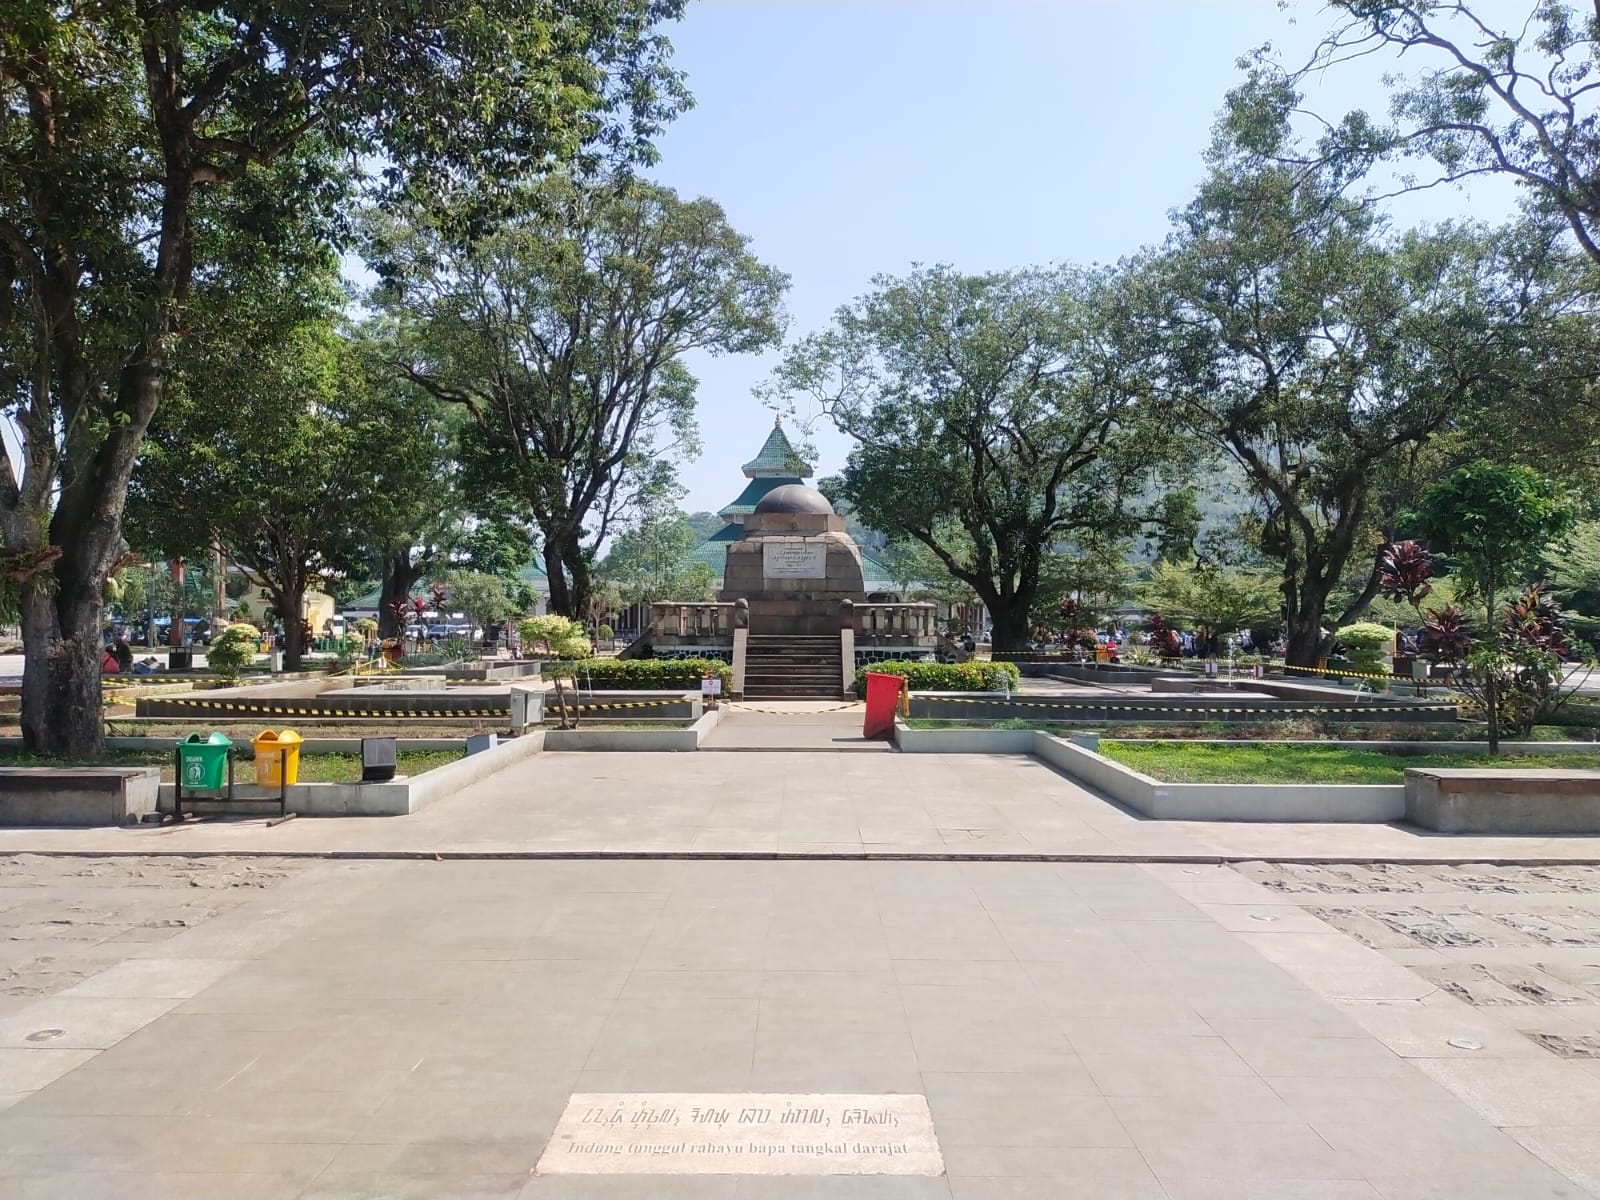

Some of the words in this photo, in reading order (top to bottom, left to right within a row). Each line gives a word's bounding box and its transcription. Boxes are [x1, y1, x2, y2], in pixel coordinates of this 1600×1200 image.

[568, 1142, 623, 1155] Indung
[628, 1142, 686, 1156] tunggul
[690, 1142, 743, 1156] rahayu
[749, 1142, 786, 1156] bapa
[791, 1142, 847, 1156] tangkal
[852, 1142, 909, 1156] darajat
